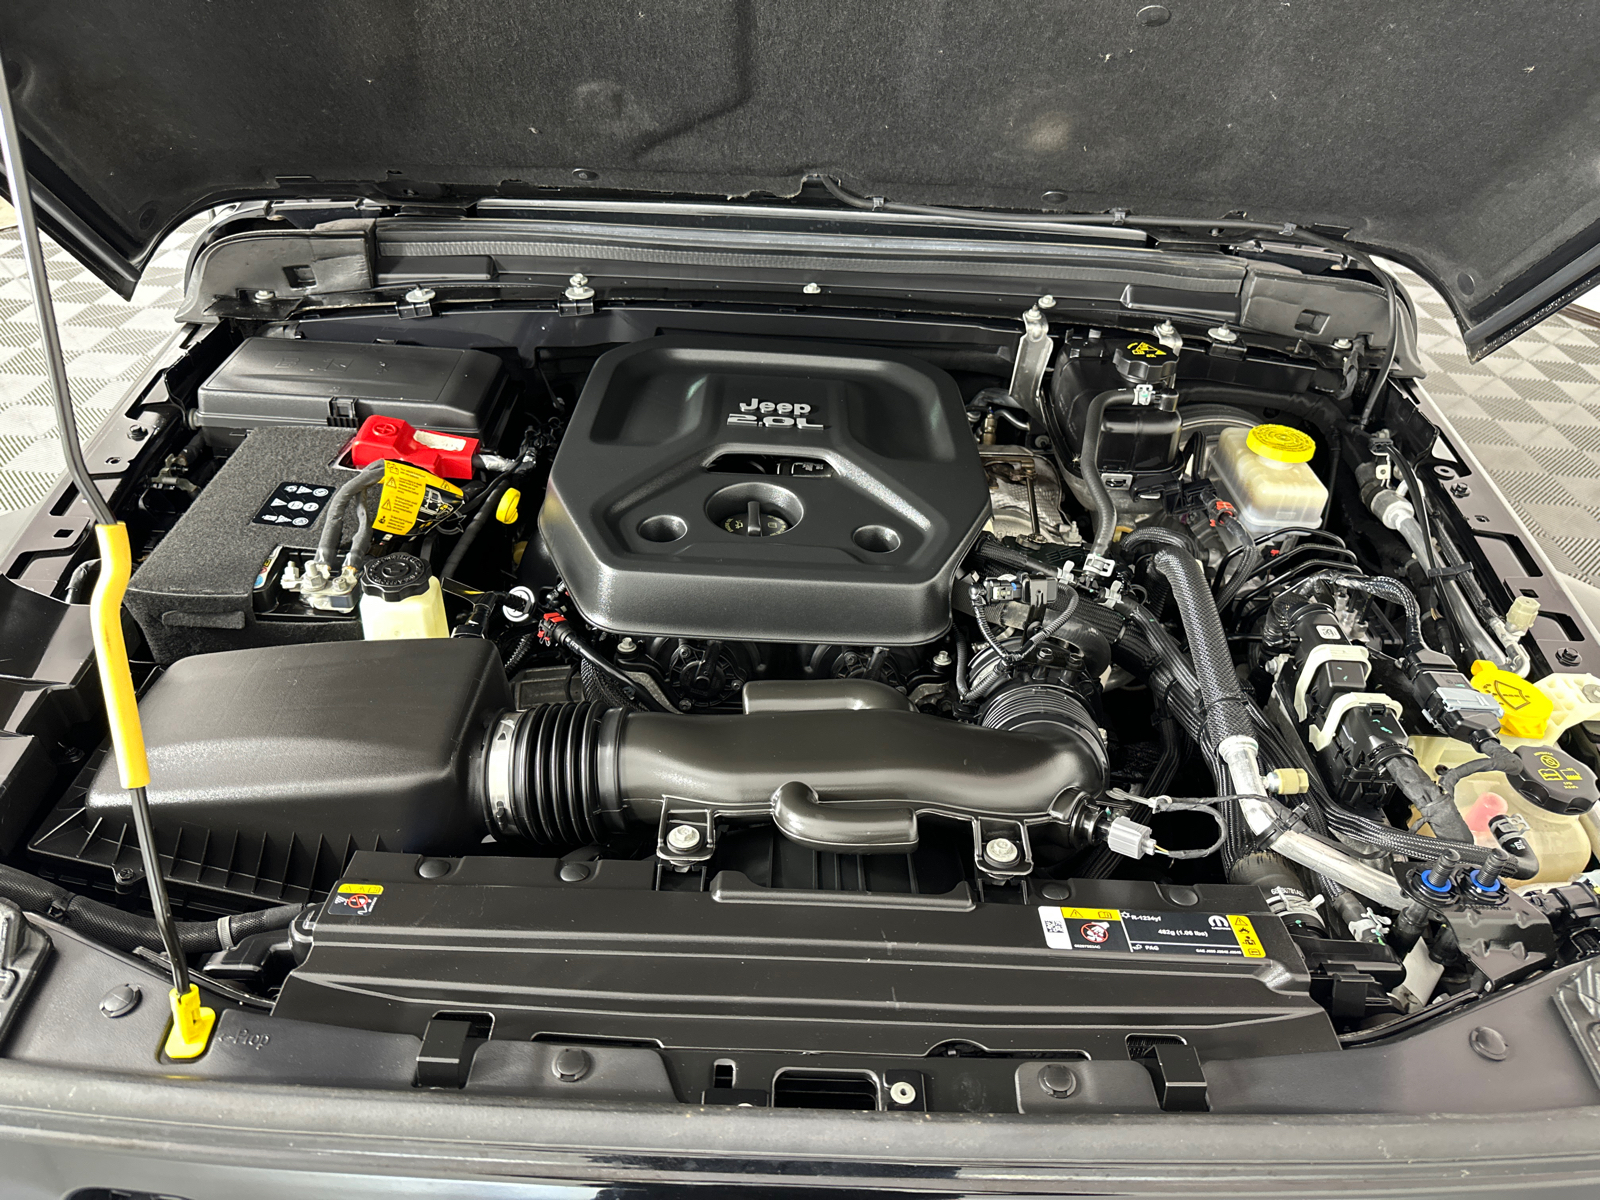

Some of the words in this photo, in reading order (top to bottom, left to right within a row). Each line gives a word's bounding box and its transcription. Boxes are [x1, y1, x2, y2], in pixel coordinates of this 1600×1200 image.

[739, 398, 811, 417] Jeep
[727, 413, 824, 430] 2.0L
[233, 1029, 270, 1050] Prop
